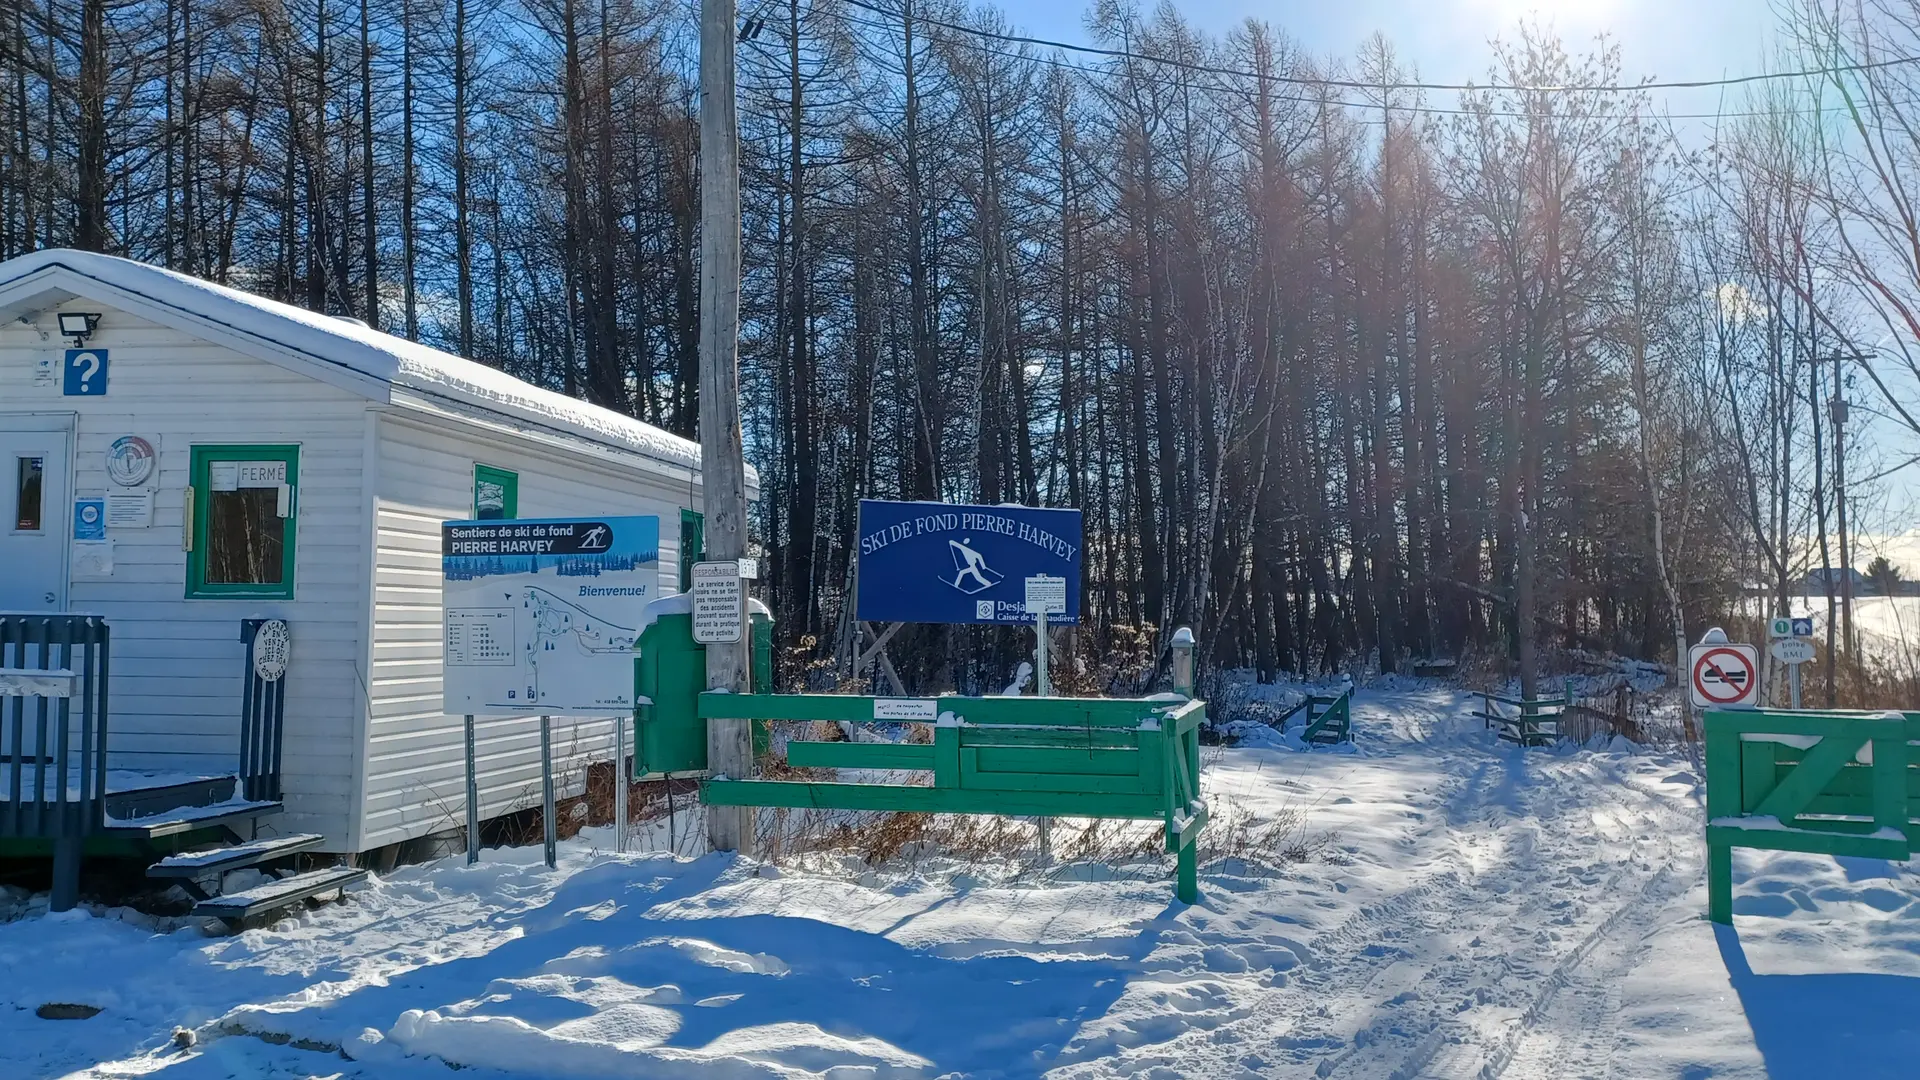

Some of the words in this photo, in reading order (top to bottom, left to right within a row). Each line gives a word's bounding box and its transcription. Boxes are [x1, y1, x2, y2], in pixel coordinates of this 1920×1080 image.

[241, 464, 285, 481] FERMÉ
[451, 527, 496, 538] Sentiers
[498, 526, 512, 537] de
[514, 525, 530, 537] ski
[532, 525, 546, 536] de
[548, 525, 574, 536] fond
[861, 528, 888, 556] SKI
[889, 520, 913, 543] DE
[915, 513, 958, 535] FOND
[961, 513, 1016, 537] PIERRE
[1017, 521, 1077, 563] HARVEY
[451, 541, 497, 553] PIERRE
[500, 540, 554, 553] HARVEY
[578, 585, 646, 597] Bienvenue!
[997, 601, 1026, 614] Desja
[997, 613, 1019, 621] Caisse
[1046, 615, 1075, 623] audière
[272, 630, 281, 638] EN
[263, 638, 284, 649] VENTE
